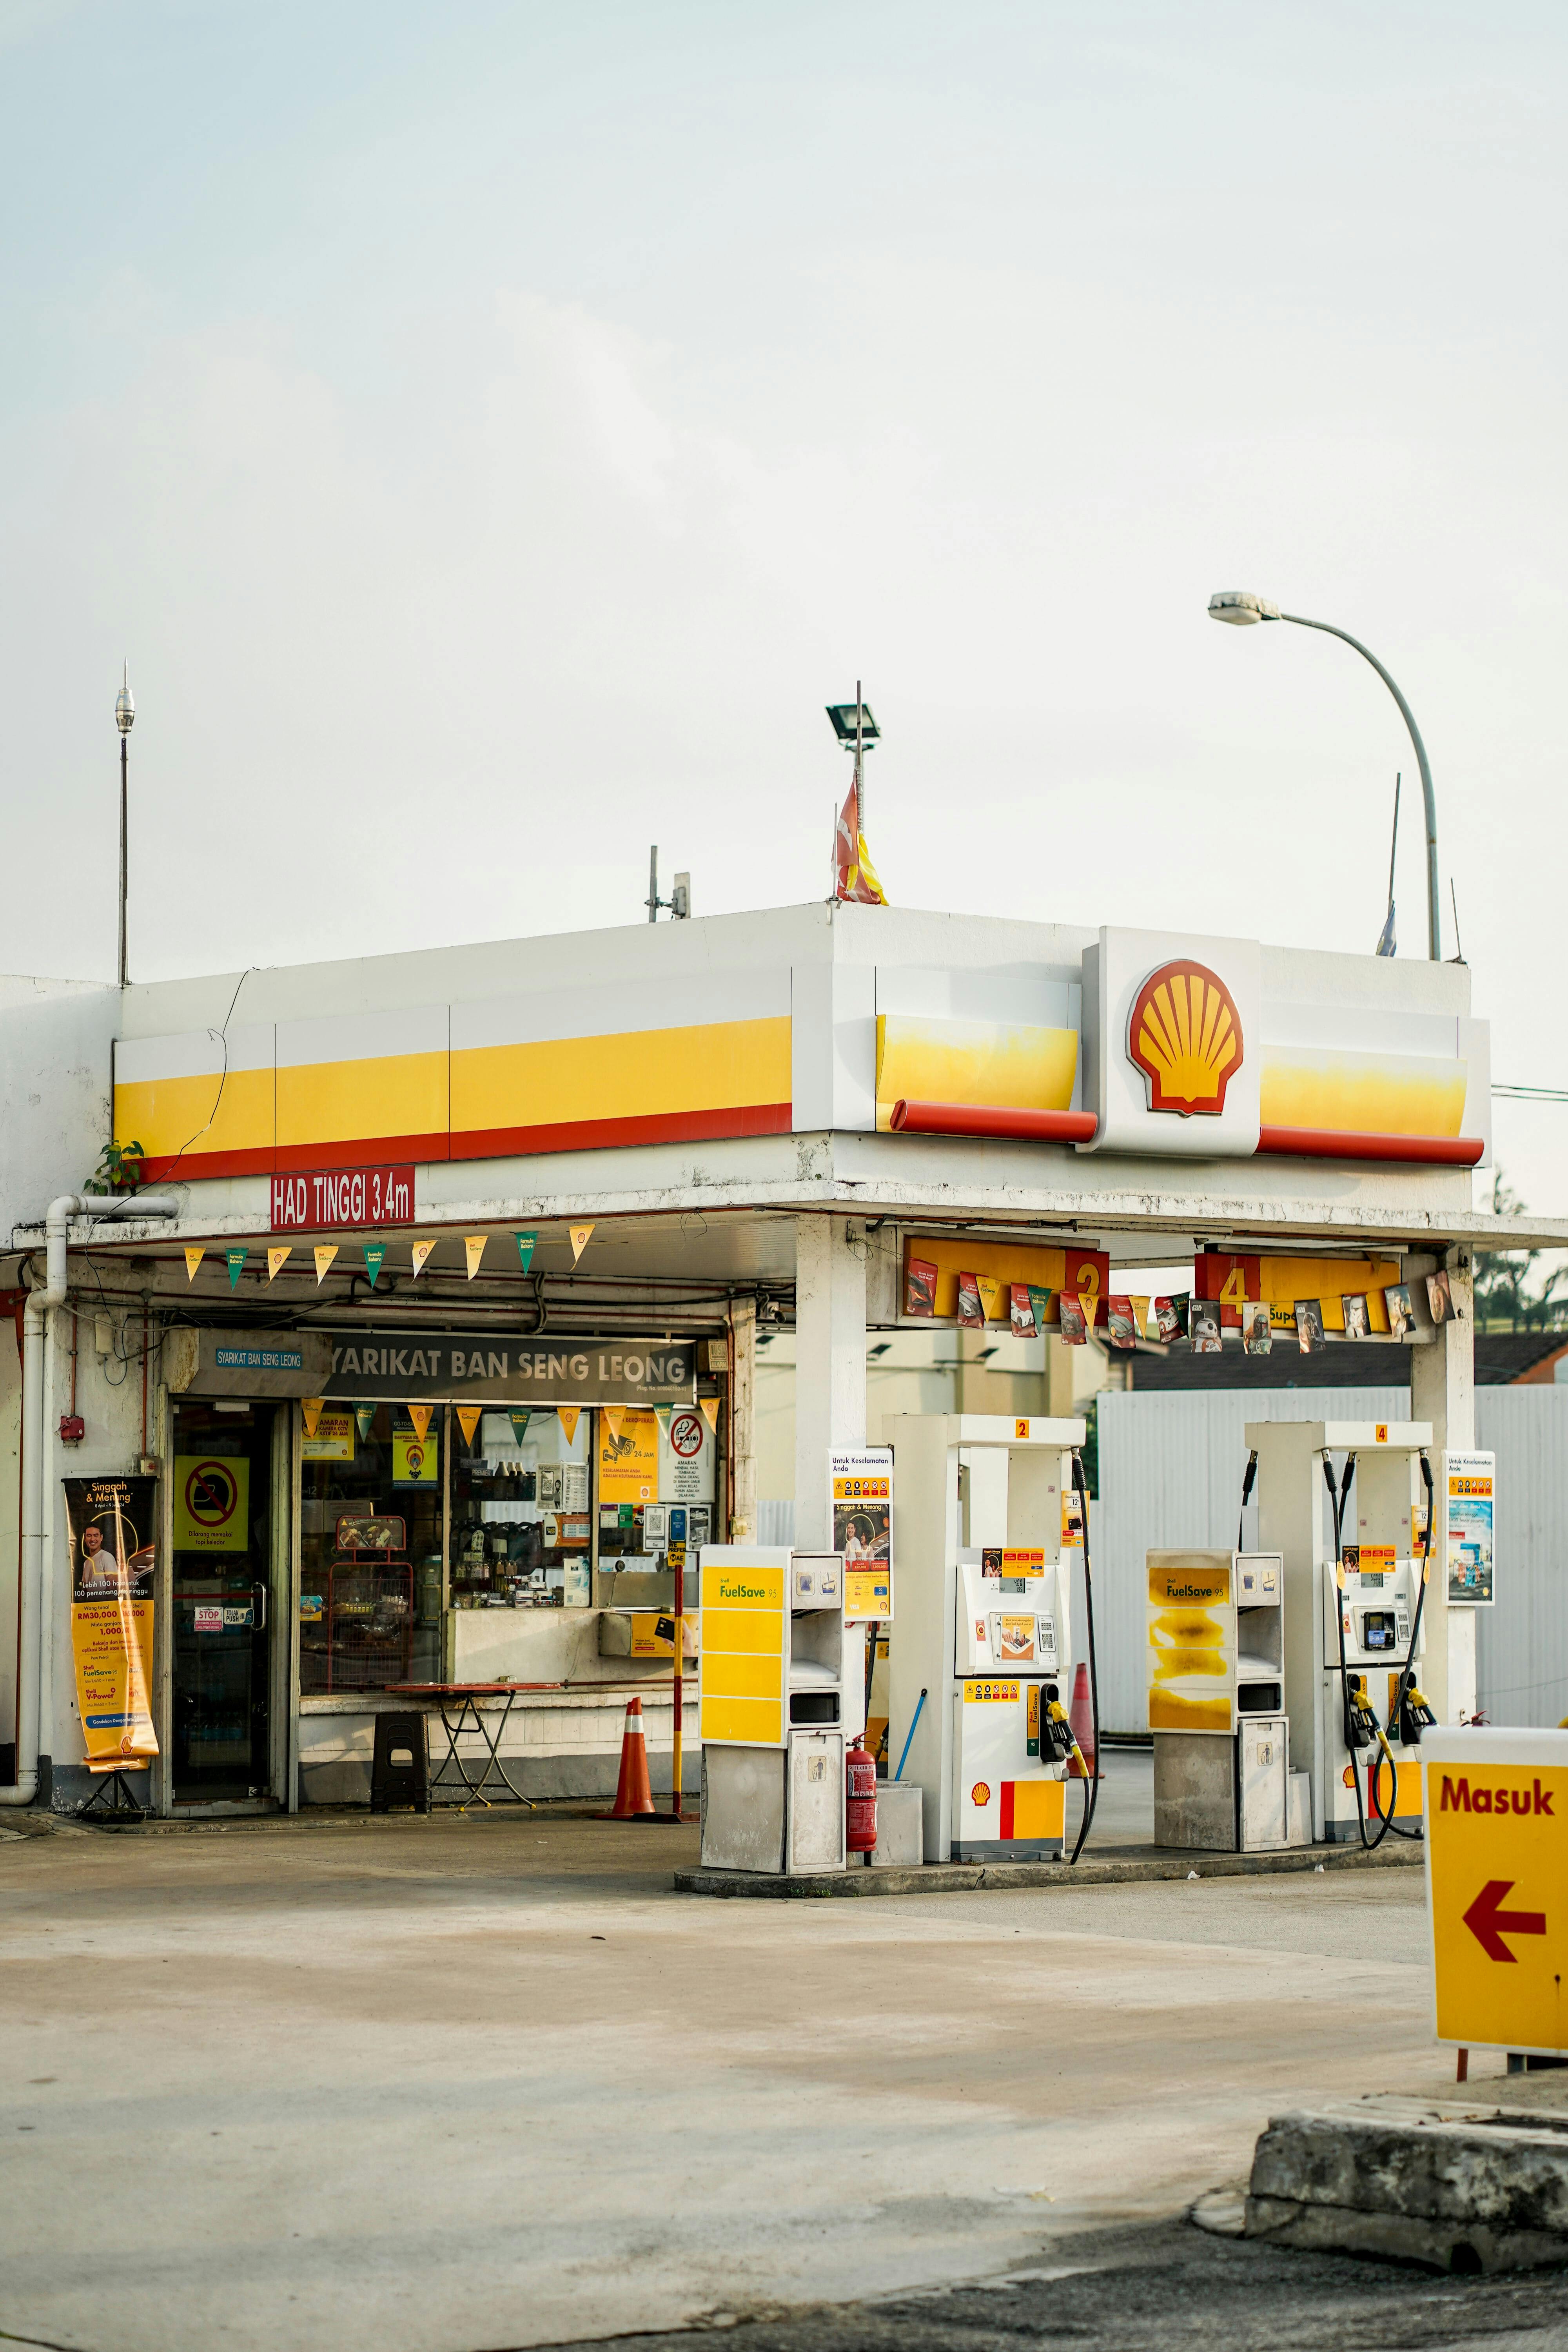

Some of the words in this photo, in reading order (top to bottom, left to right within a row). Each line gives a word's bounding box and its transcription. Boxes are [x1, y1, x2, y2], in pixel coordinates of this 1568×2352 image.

[274, 1178, 307, 1225] HAD
[314, 1174, 365, 1223] TINGGI
[373, 1172, 408, 1220] 3.4m
[1076, 1263, 1099, 1294] 2
[1220, 1268, 1249, 1314] 4
[1270, 1308, 1296, 1324] Supe
[218, 1351, 246, 1364] SYARIKAT
[248, 1353, 260, 1365] BAN
[262, 1354, 279, 1366] SENG
[280, 1354, 301, 1367] LEONG
[332, 1347, 441, 1376] YARIKAT
[452, 1351, 508, 1378] BAN
[518, 1352, 589, 1381] SENG
[599, 1355, 686, 1383] LEONG
[1019, 1422, 1026, 1436] 2
[1378, 1427, 1386, 1440] 4
[92, 1481, 127, 1493] Singgah
[86, 1493, 93, 1502] &
[720, 1584, 765, 1597] FuelSave
[768, 1589, 777, 1598] 95
[1167, 1584, 1212, 1597] FuelSave
[1215, 1588, 1223, 1597] 95
[78, 1611, 117, 1620] RM30,000
[199, 1611, 219, 1619] STOP
[1440, 1777, 1555, 1816] Masuk
